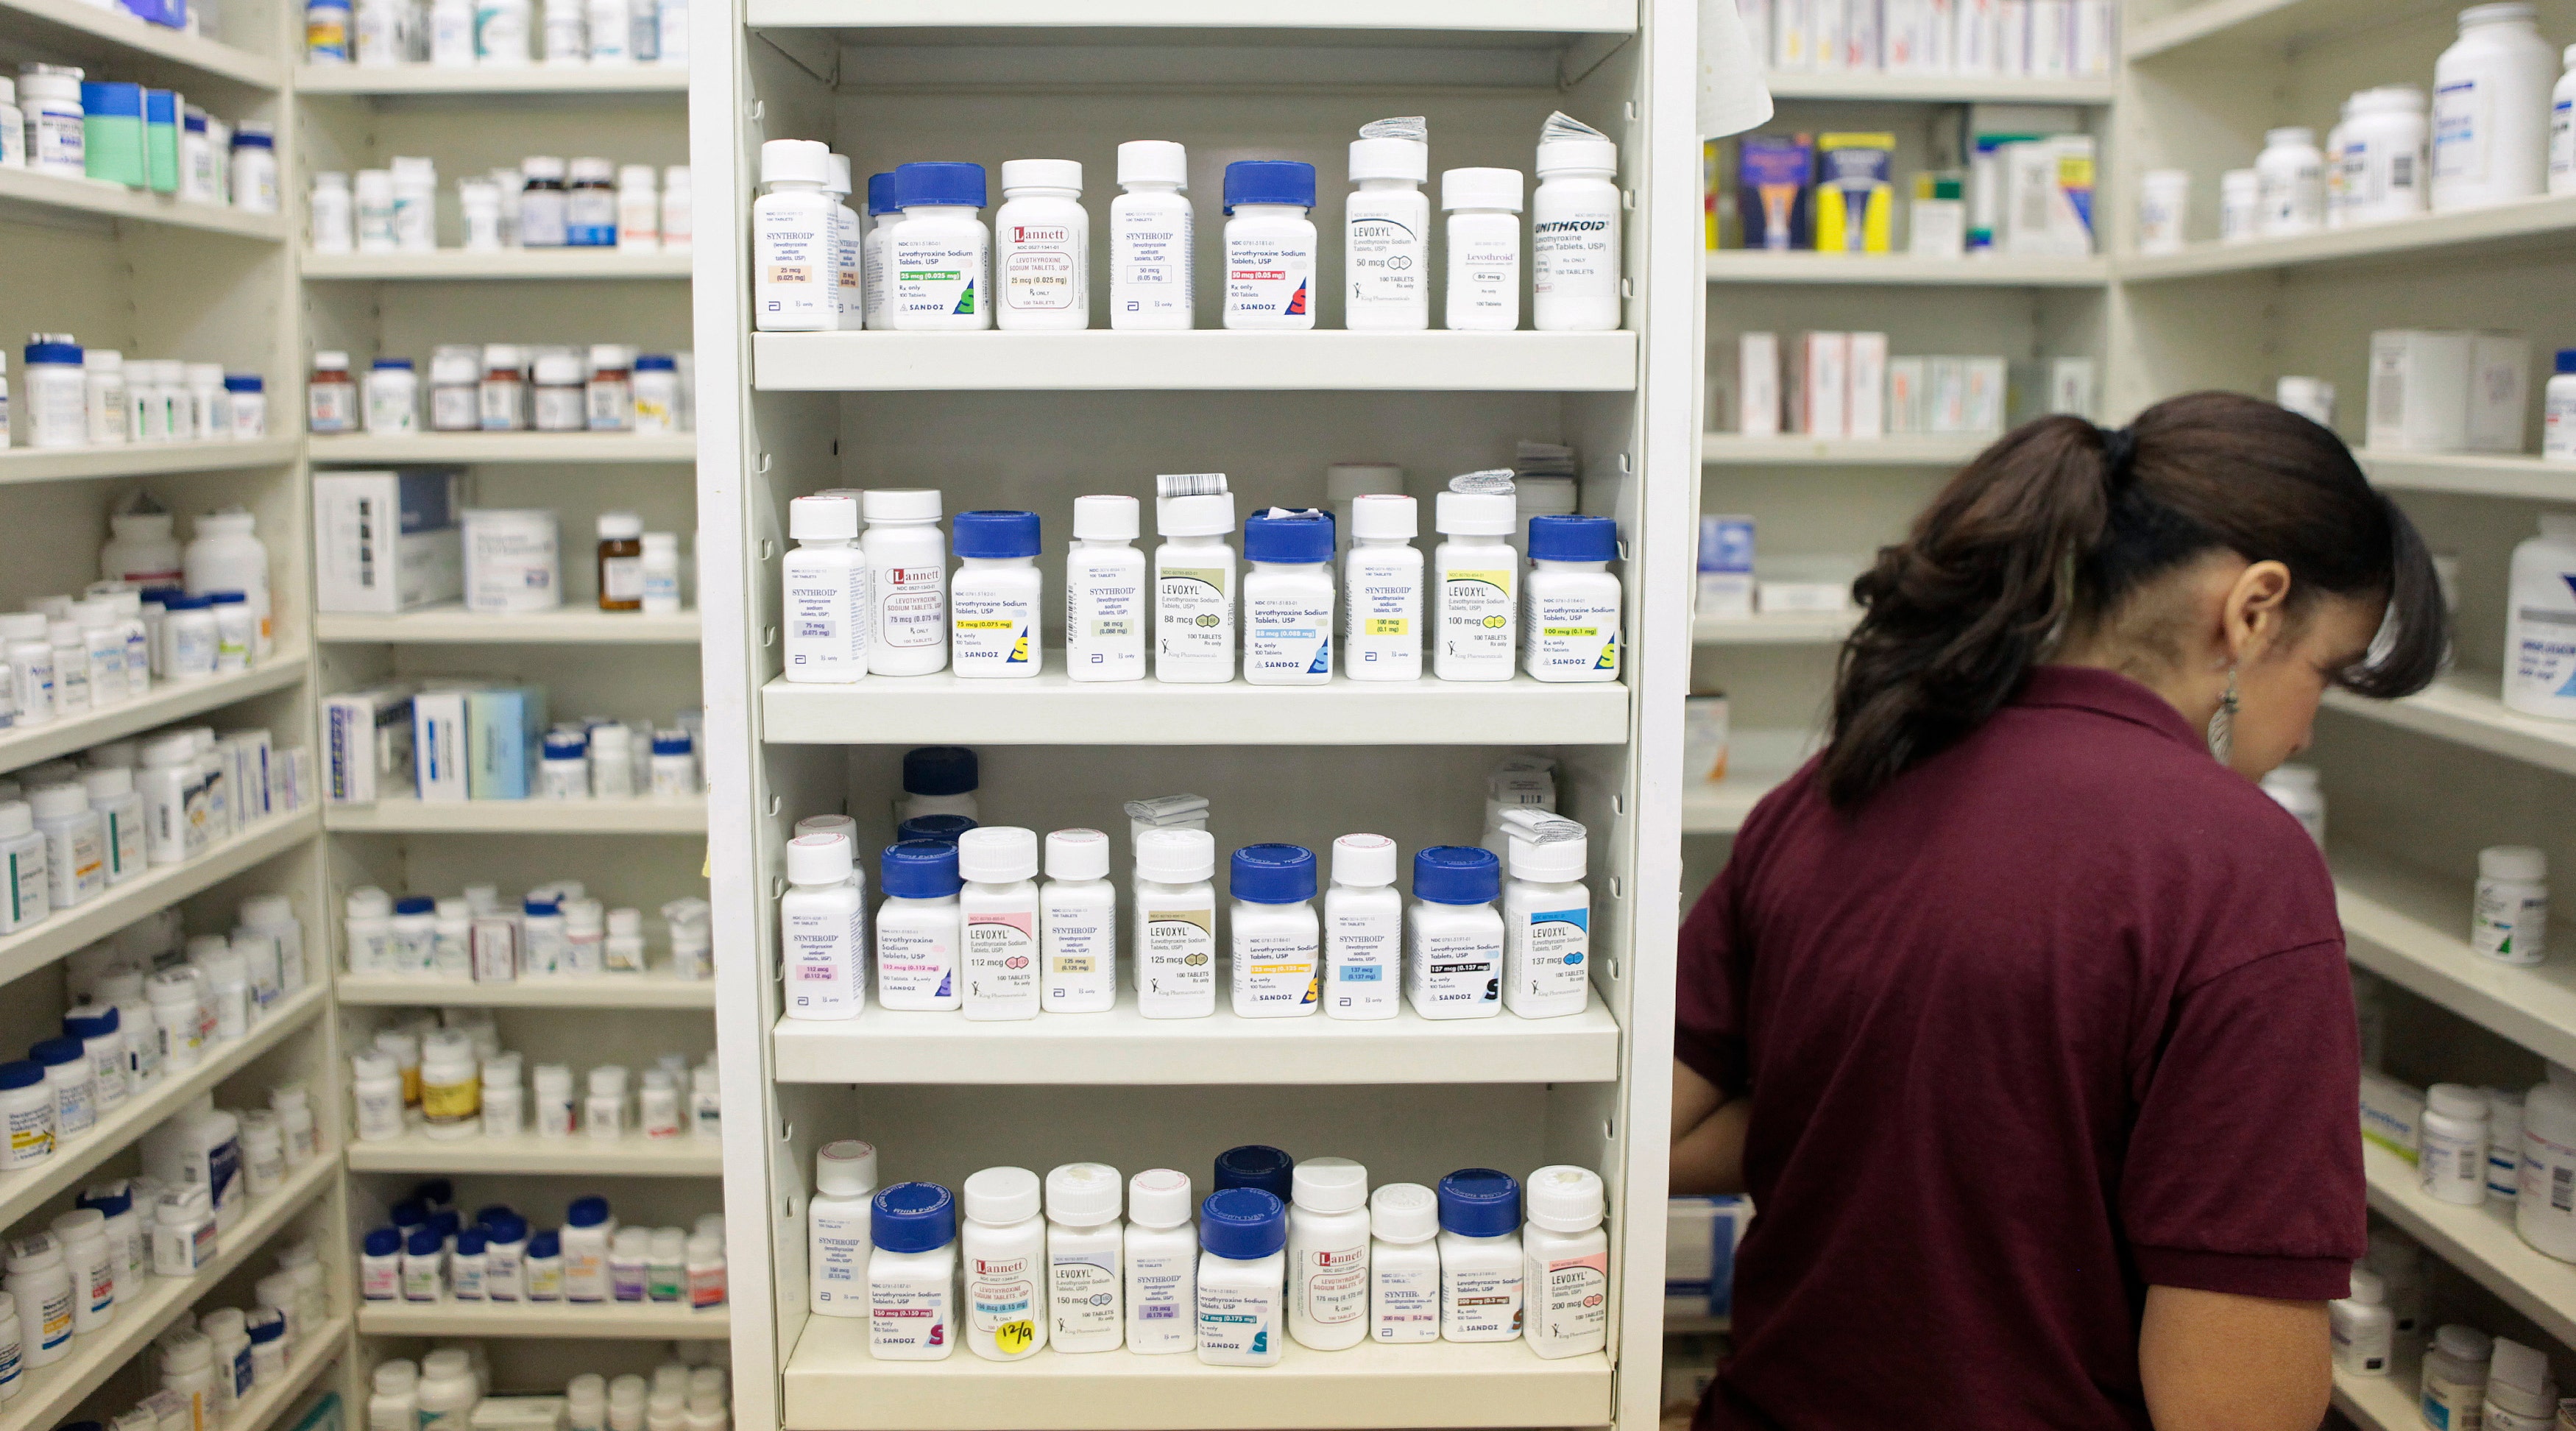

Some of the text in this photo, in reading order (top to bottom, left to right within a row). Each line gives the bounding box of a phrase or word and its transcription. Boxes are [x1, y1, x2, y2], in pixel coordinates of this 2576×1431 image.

[1014, 227, 1064, 243] Lannett
[1368, 259, 1385, 268] mcg
[1055, 277, 1067, 285] mg)
[894, 569, 938, 584] Lannett
[896, 596, 936, 604] LEVOTHYROXINE
[1176, 616, 1193, 624] mcg
[1464, 618, 1481, 626] mcg
[987, 959, 1003, 967] mcg
[1167, 956, 1183, 964] mcg
[977, 1259, 1022, 1274] Lannett
